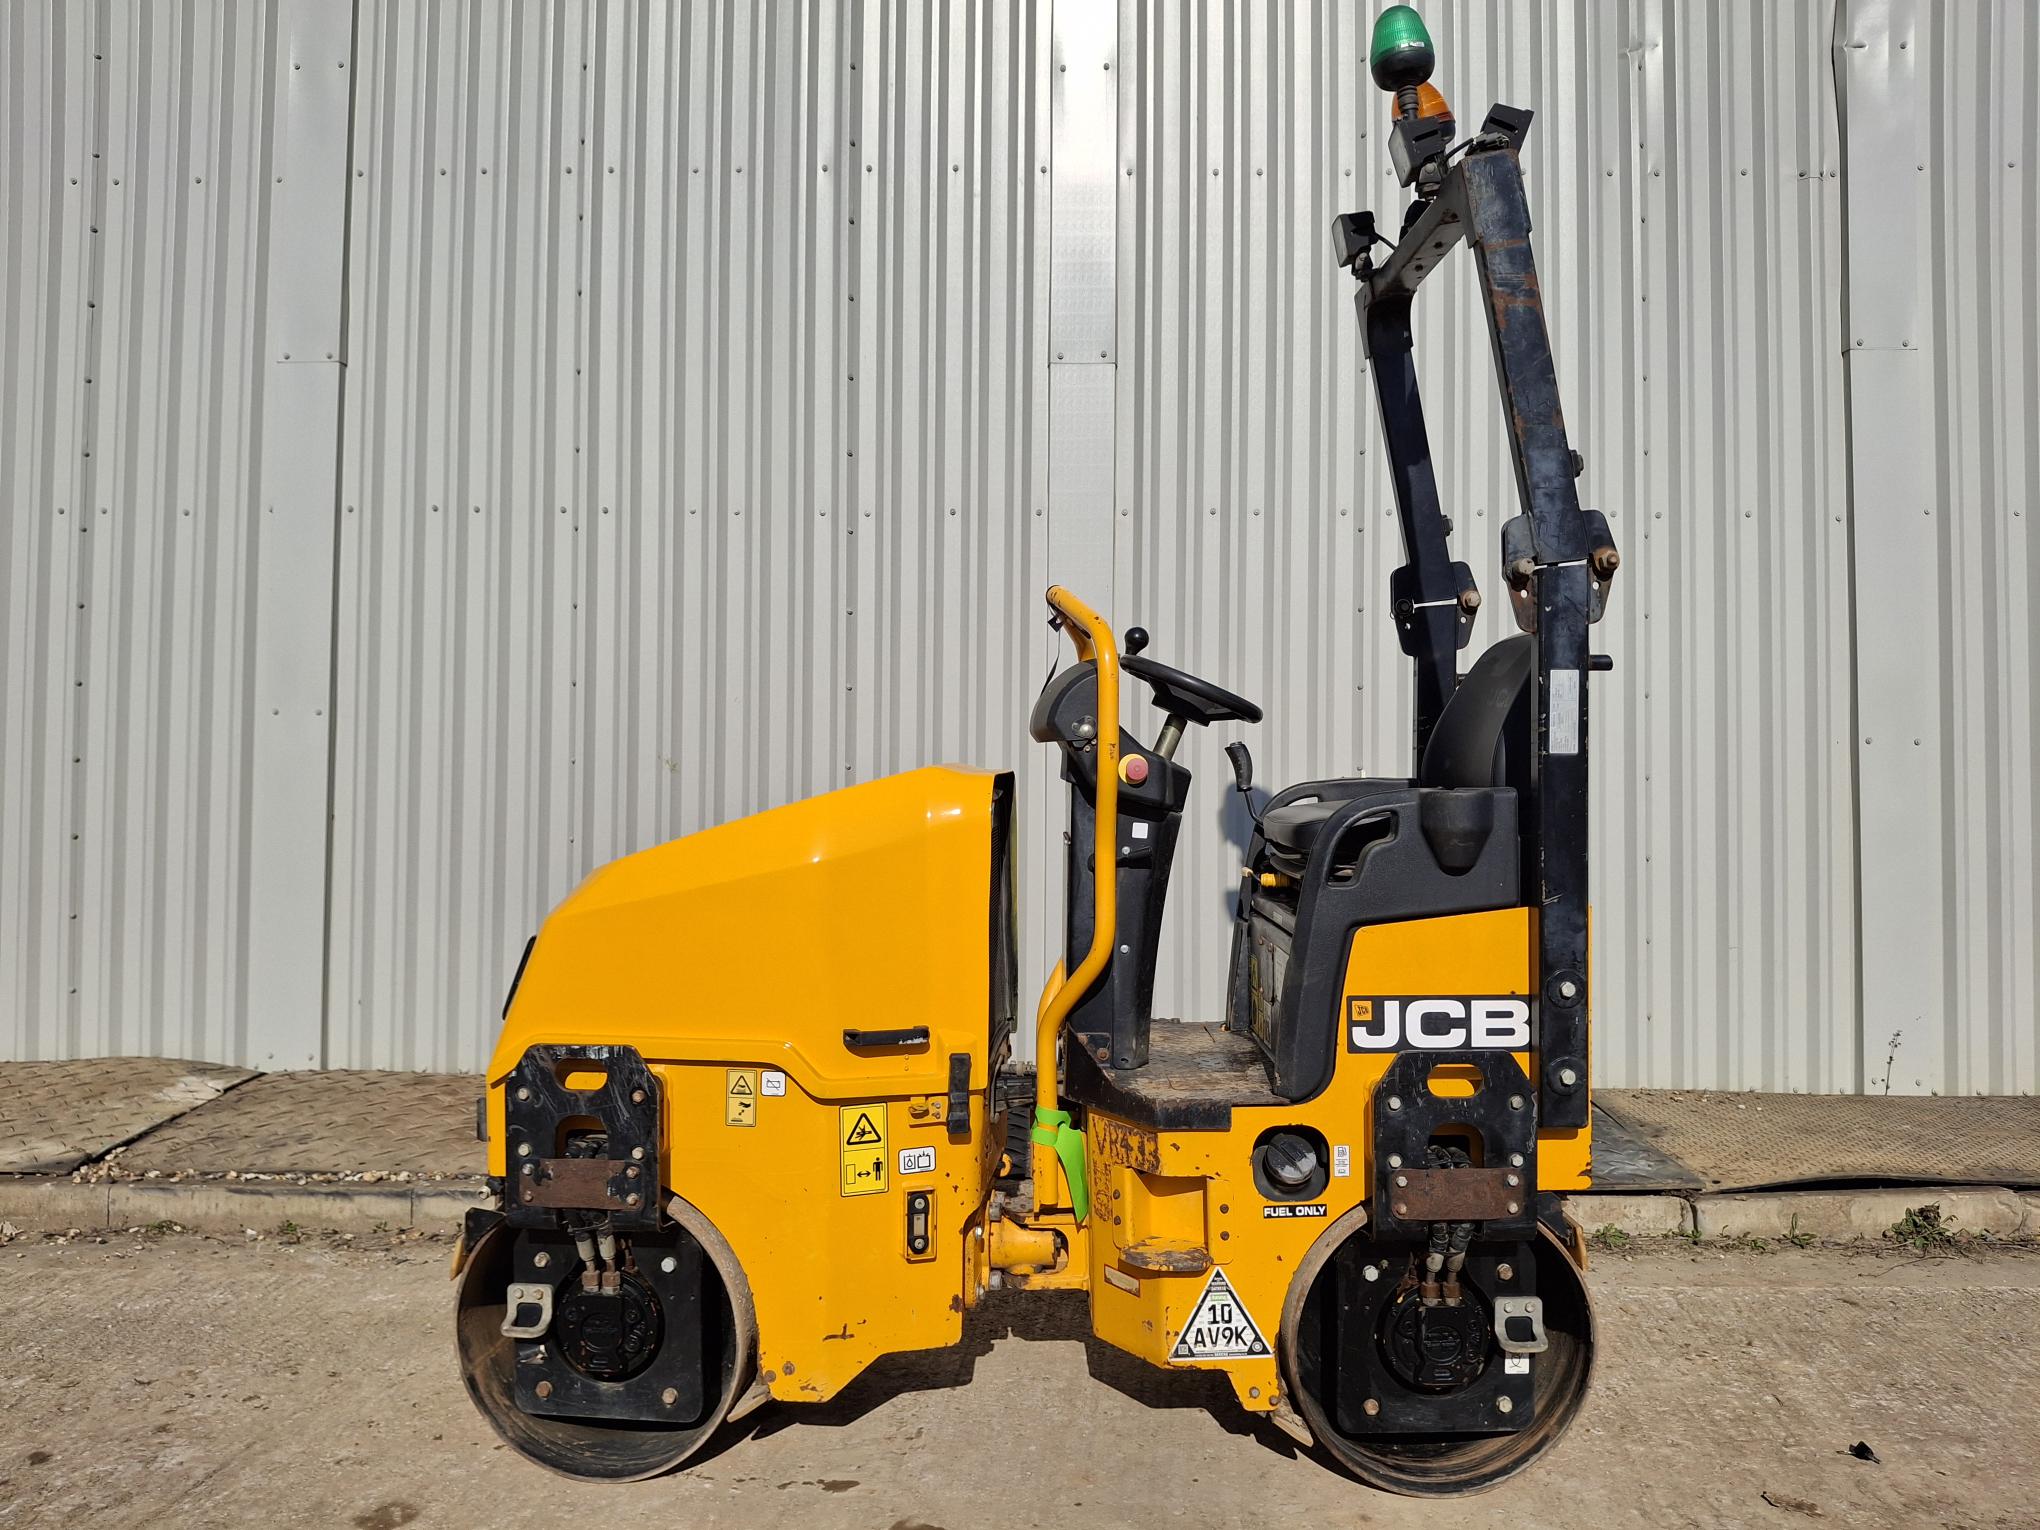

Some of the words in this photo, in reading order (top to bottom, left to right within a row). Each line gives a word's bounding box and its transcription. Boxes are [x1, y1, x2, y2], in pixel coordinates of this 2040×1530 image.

[1351, 999, 1530, 1049] JCB
[1264, 1207, 1293, 1217] FUEL
[1295, 1206, 1326, 1216] ONLY
[1207, 1303, 1233, 1325] 10
[1193, 1326, 1249, 1348] AV9K
